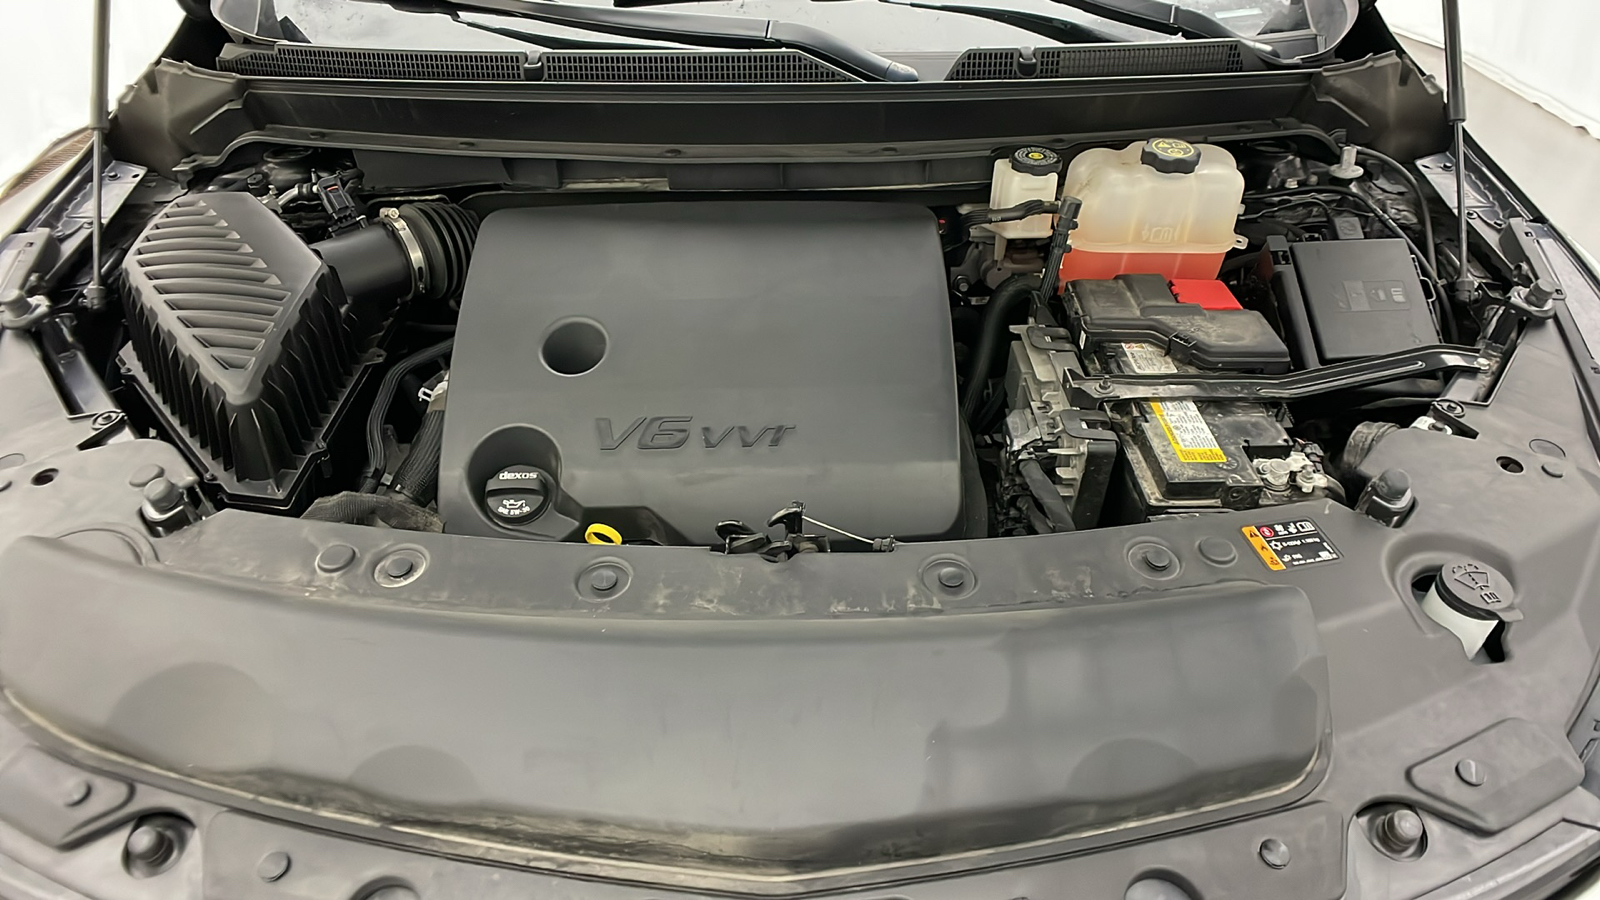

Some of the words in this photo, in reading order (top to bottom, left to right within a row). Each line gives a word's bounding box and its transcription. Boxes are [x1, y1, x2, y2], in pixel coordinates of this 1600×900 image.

[595, 415, 693, 450] V6
[701, 424, 796, 449] VVT
[499, 471, 538, 480] dexos
[509, 505, 531, 515] 5W-30
